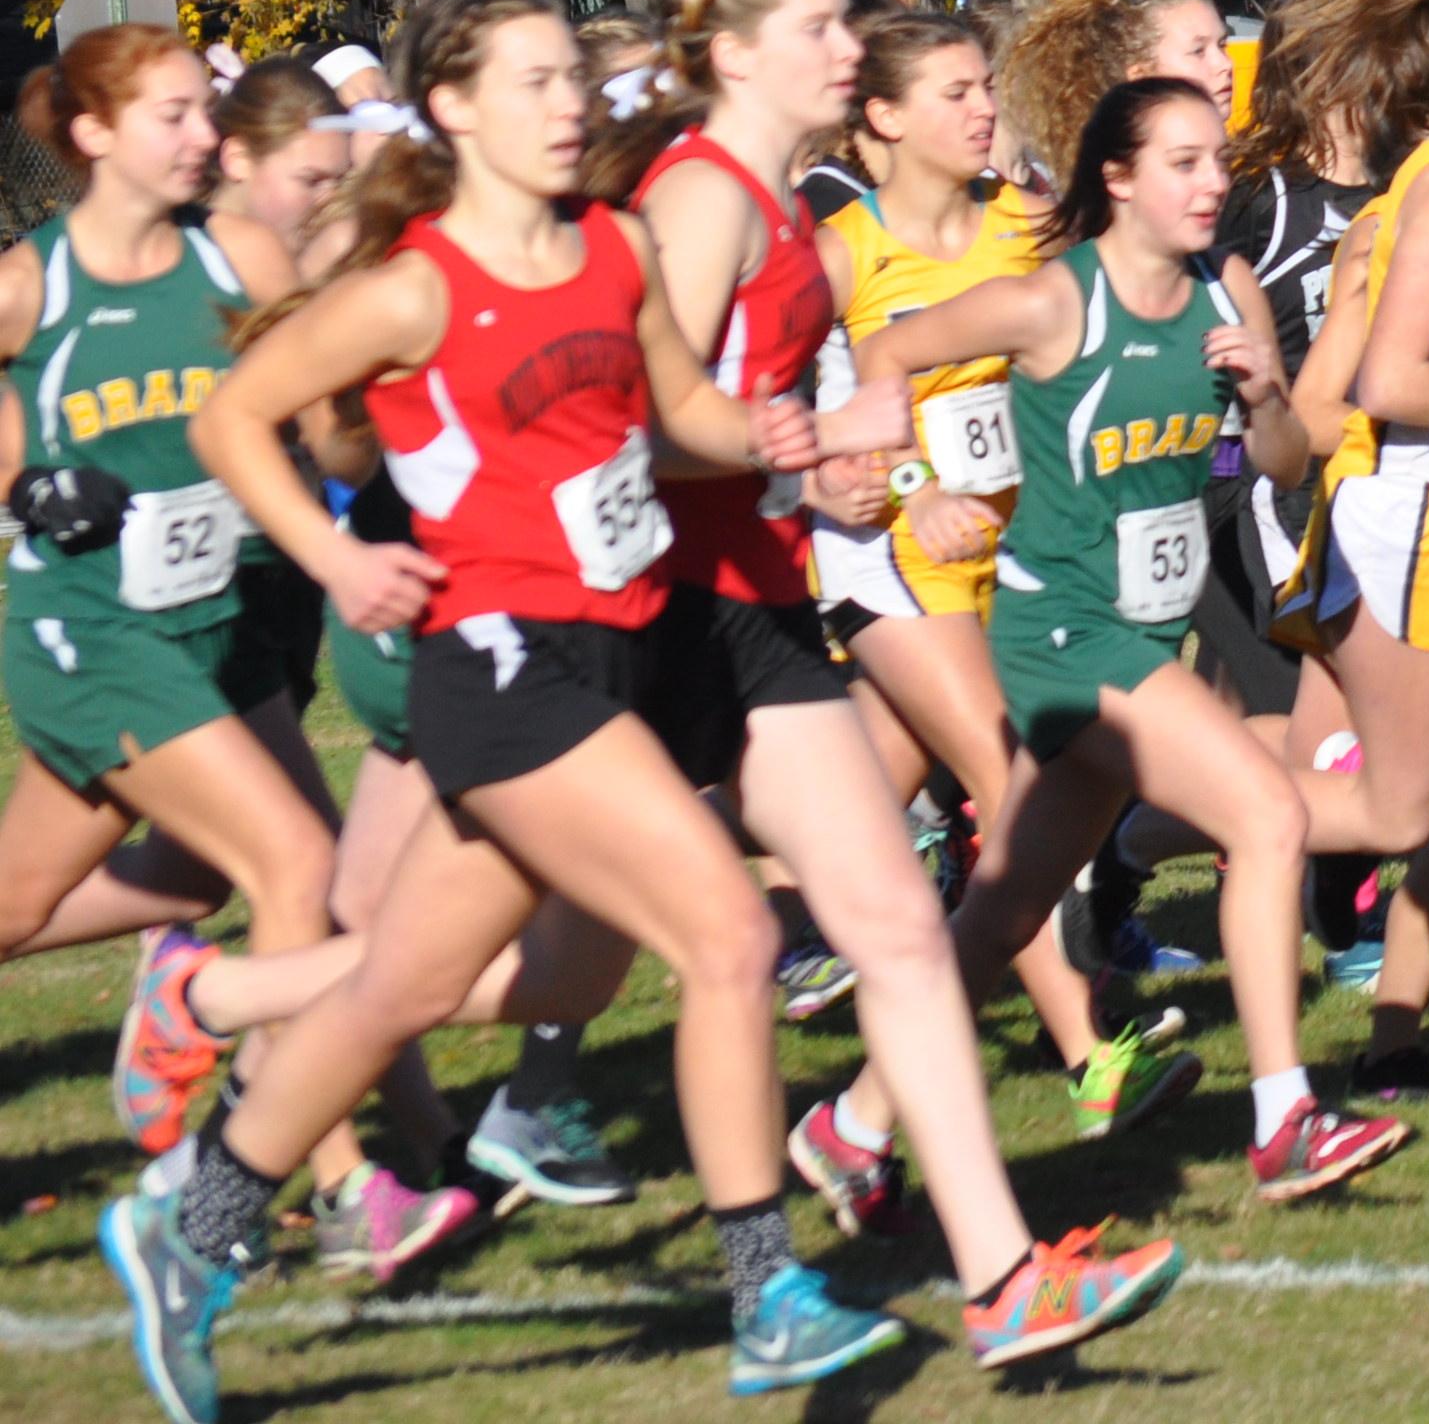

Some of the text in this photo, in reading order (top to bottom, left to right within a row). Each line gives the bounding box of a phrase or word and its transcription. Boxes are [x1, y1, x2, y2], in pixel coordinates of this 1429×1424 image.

[966, 413, 1007, 459] 81
[165, 514, 215, 565] 52
[1152, 534, 1188, 582] 53
